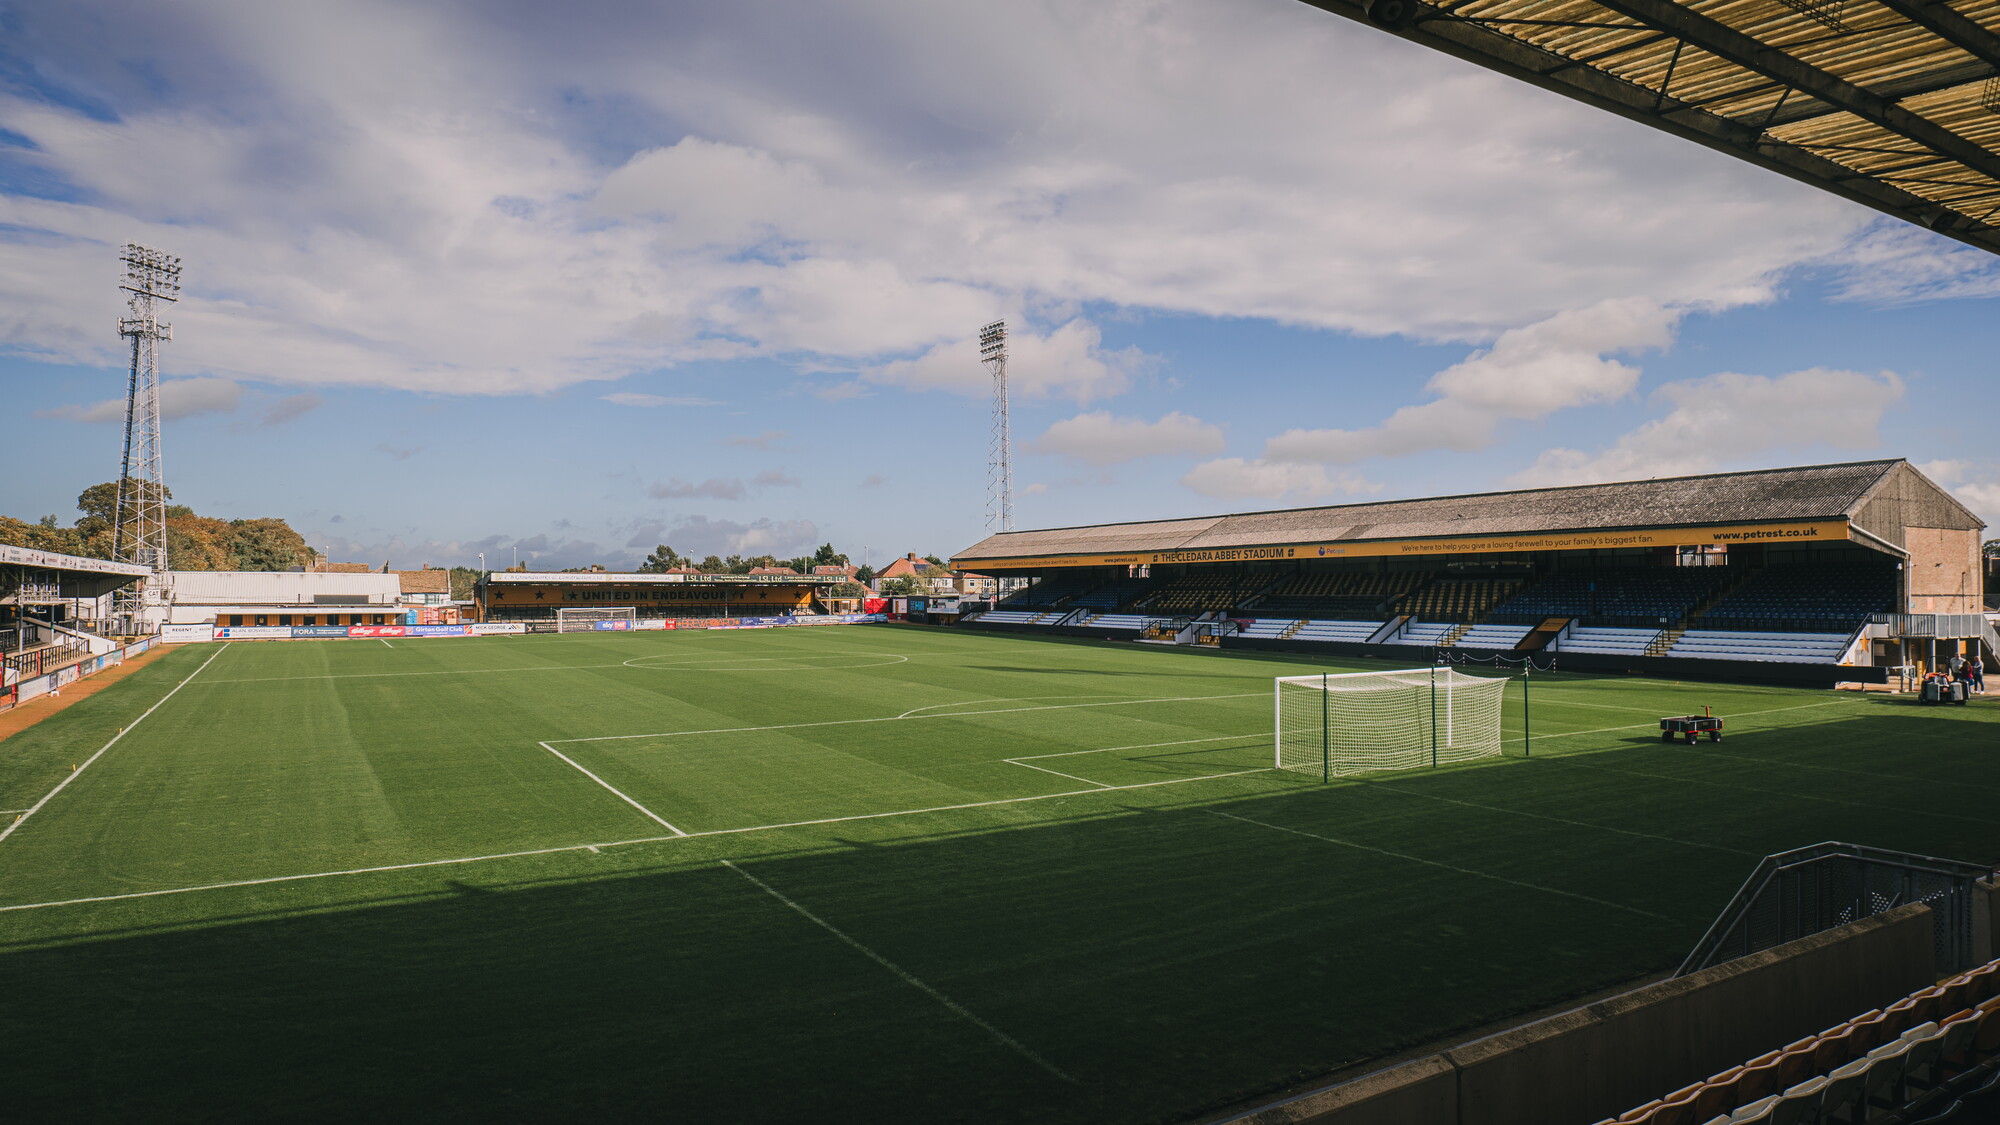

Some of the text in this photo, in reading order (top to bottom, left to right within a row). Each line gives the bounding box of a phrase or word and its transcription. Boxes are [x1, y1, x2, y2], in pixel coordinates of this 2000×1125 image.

[1713, 527, 1817, 540] www.petrest.co.uk
[1443, 543, 1456, 552] help
[1471, 542, 1485, 550] give
[1492, 541, 1513, 549] loving
[1515, 539, 1543, 547] farewell
[1573, 536, 1603, 546] family's
[1605, 535, 1636, 545] biggest
[1638, 534, 1654, 542] fan.
[1162, 548, 1284, 562] THE CLEDARA ABBEY STADIUM
[581, 591, 726, 600] UNITED IN ENDEAVOUR
[602, 621, 614, 630] sky
